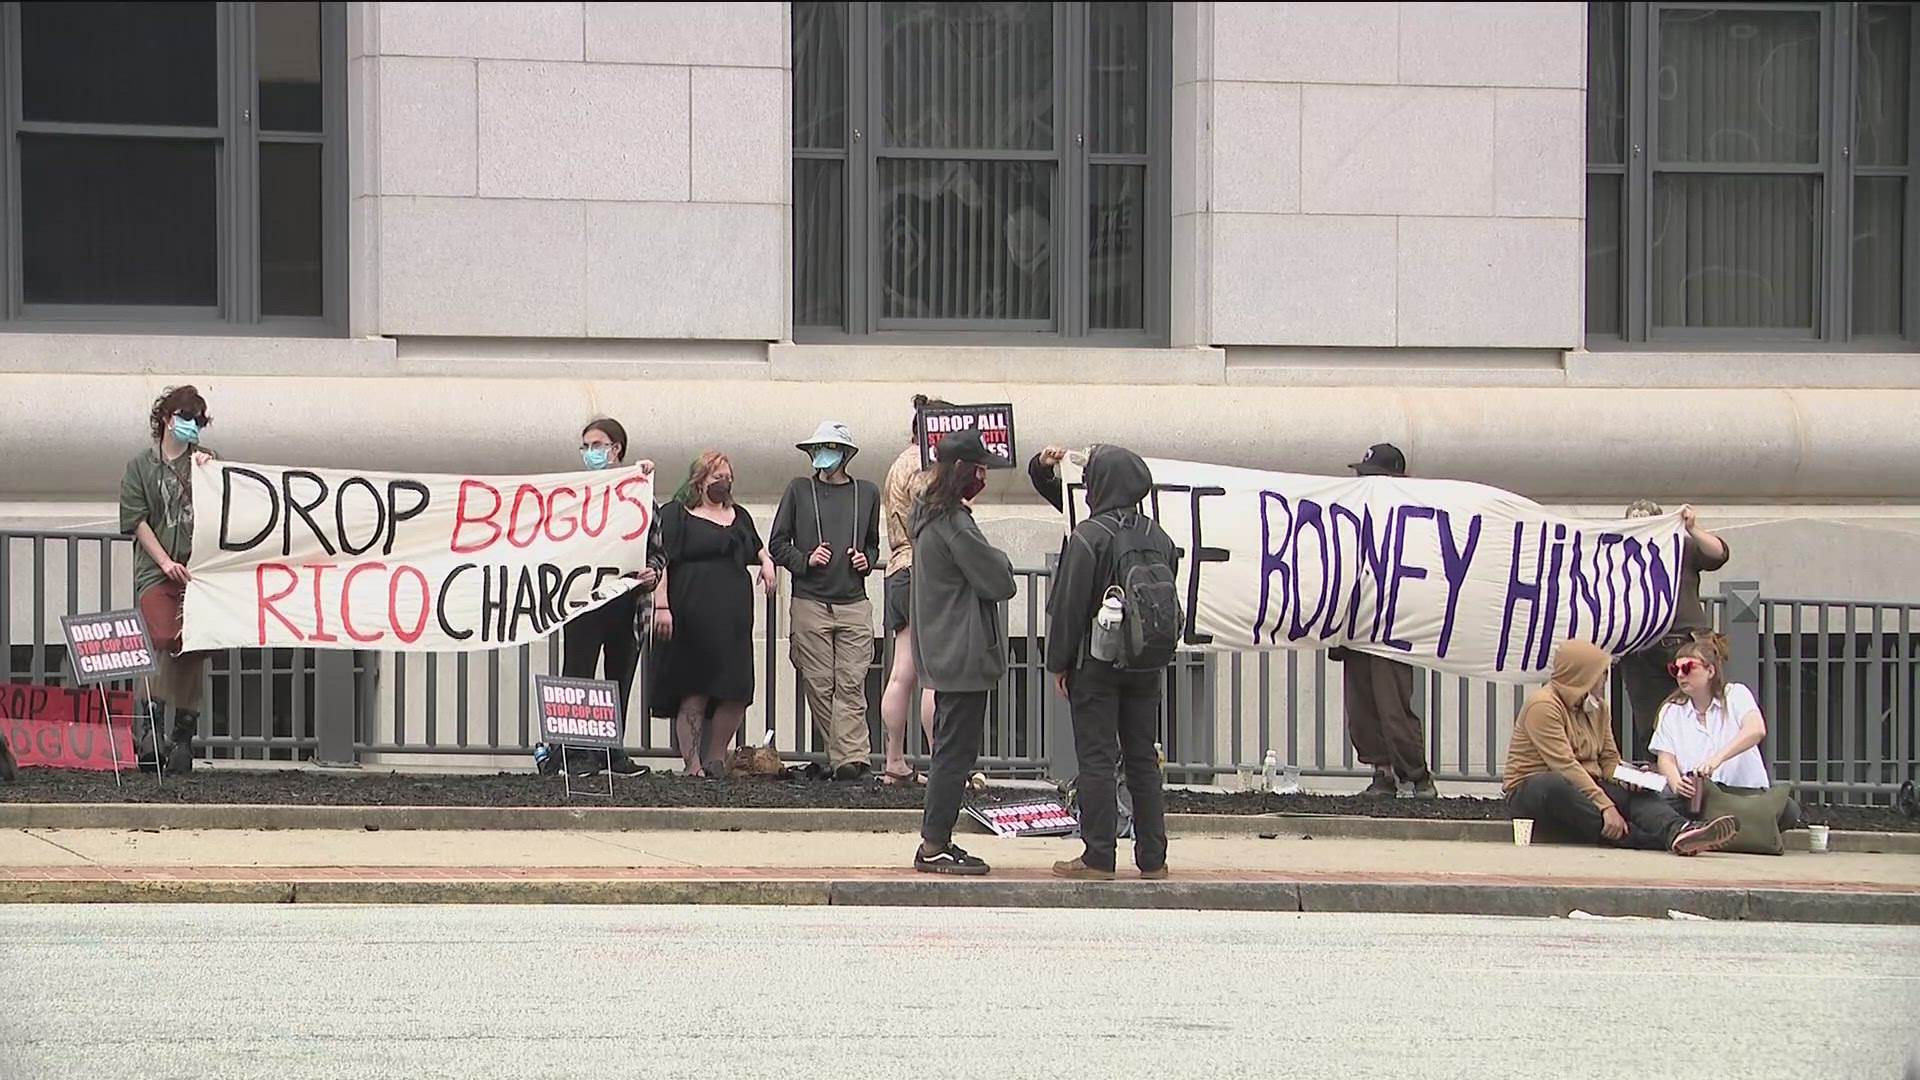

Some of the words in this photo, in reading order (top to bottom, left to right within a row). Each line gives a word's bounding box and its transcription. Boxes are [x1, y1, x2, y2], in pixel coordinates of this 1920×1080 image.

[926, 415, 973, 432] DROP
[978, 413, 1006, 430] ALL
[219, 466, 430, 557] DROP
[450, 475, 650, 554] BOGUS
[1253, 489, 1483, 659] RODNEY
[255, 560, 430, 646] RICO
[70, 622, 113, 642] DROP
[114, 619, 142, 638] ALL
[76, 640, 101, 656] STOP
[102, 639, 122, 653] COP
[122, 635, 144, 651] CITY
[80, 649, 151, 673] CHARGES
[543, 686, 585, 704] DROP
[588, 689, 615, 707] ALL
[0, 687, 48, 721] ROP
[63, 687, 129, 730] THE
[545, 704, 570, 716] STOP
[571, 705, 592, 719] COP
[592, 707, 615, 721] CITY
[547, 717, 616, 737] CHARGES
[0, 725, 124, 760] OGUS
